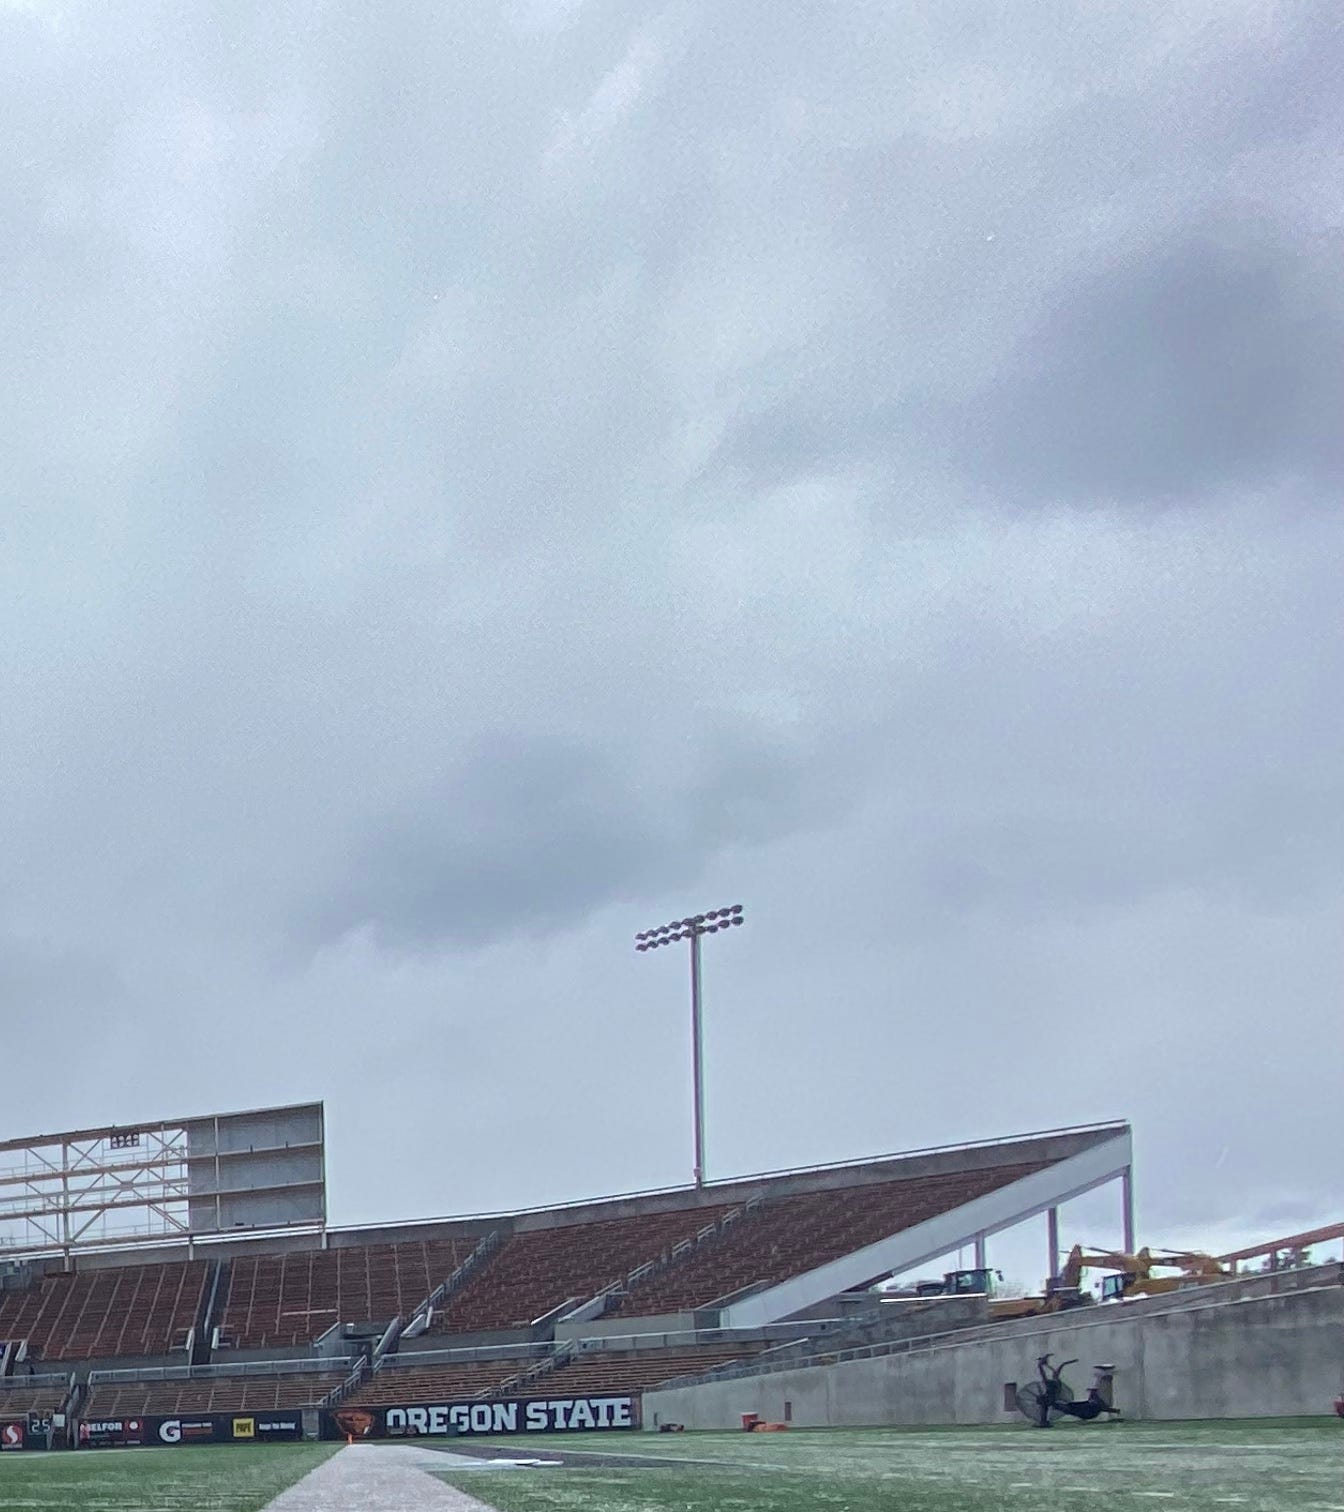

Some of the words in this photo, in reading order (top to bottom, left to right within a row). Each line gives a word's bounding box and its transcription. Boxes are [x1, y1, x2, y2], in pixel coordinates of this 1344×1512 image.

[386, 1403, 517, 1434] OREGON
[526, 1397, 631, 1430] STATE
[31, 1419, 51, 1432] 25
[88, 1422, 122, 1431] ELFOR
